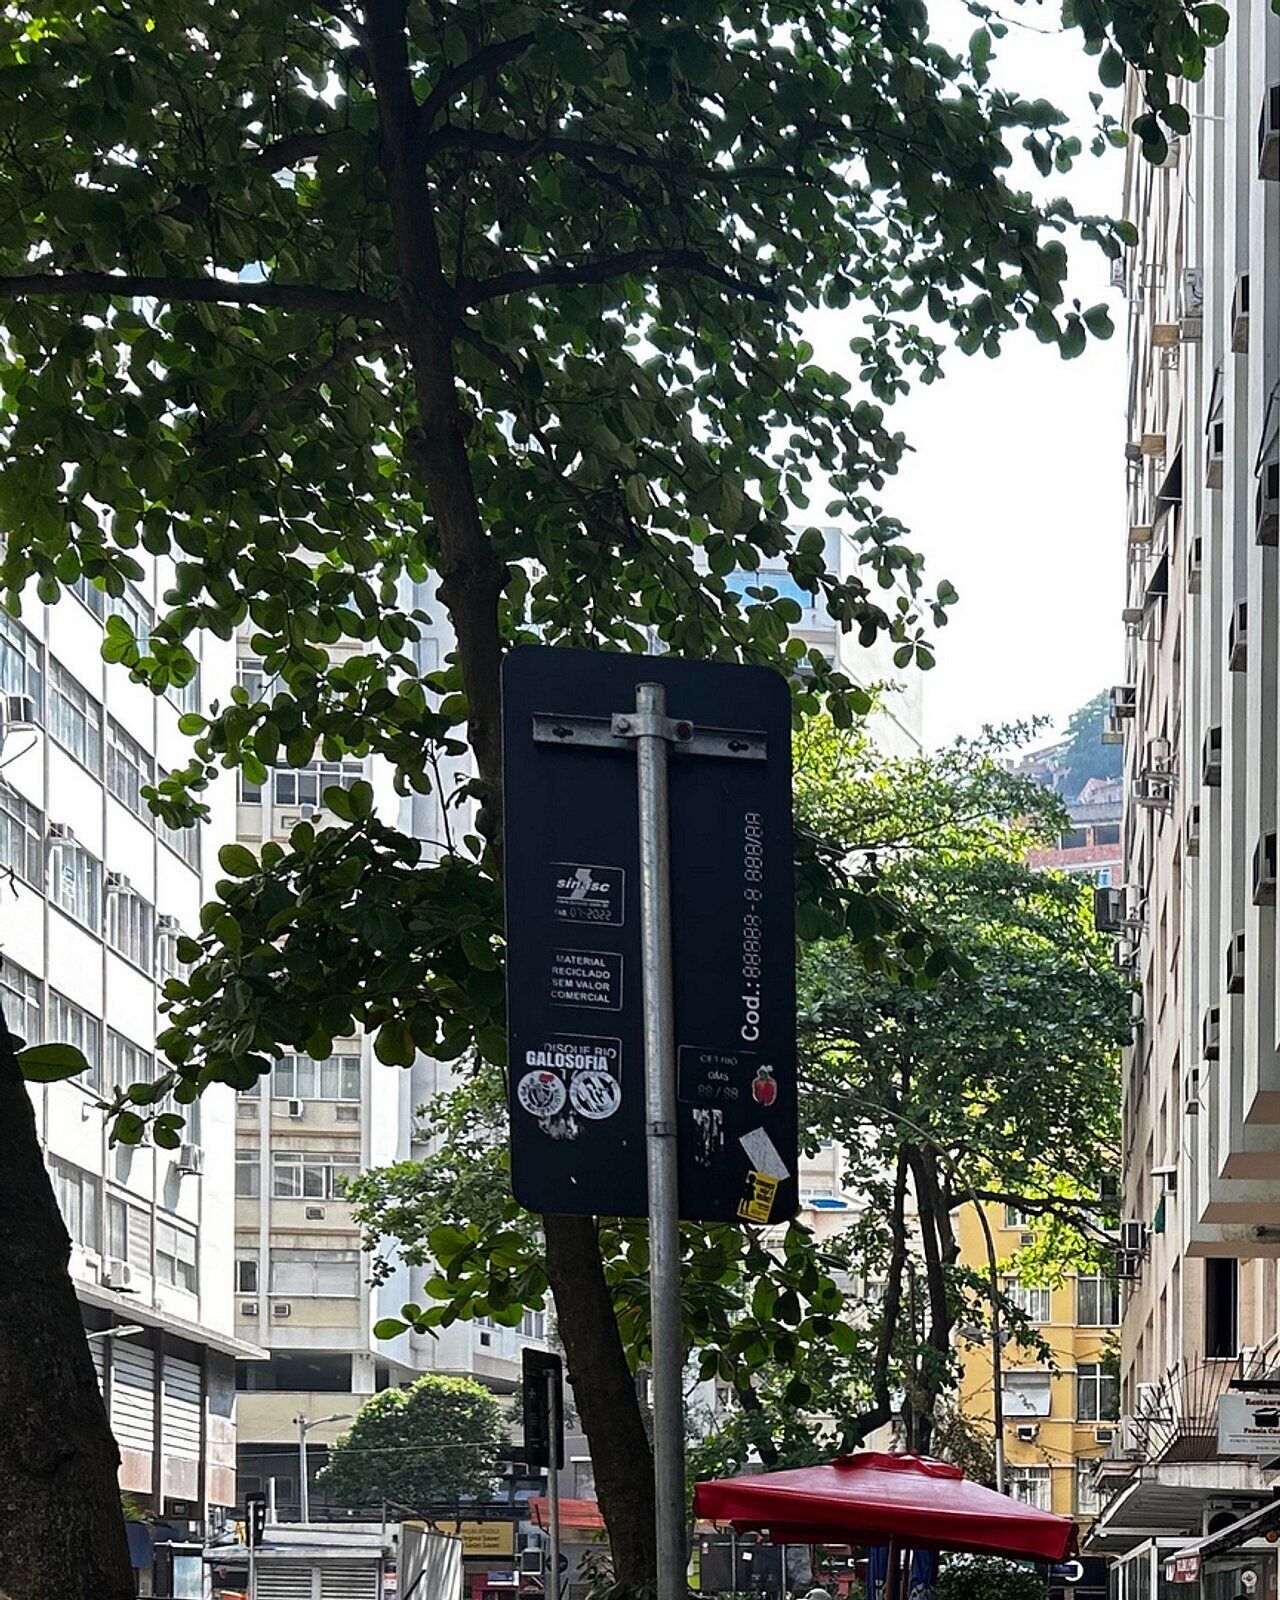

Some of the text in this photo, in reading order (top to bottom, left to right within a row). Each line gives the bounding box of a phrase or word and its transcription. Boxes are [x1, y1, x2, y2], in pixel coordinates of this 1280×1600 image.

[555, 955, 606, 967] MATERIAL
[551, 966, 611, 980] RECICLADO
[551, 978, 611, 992] SEM VALOR
[551, 989, 610, 1003] COMERCIAL
[526, 1050, 609, 1071] GALOSOFIA
